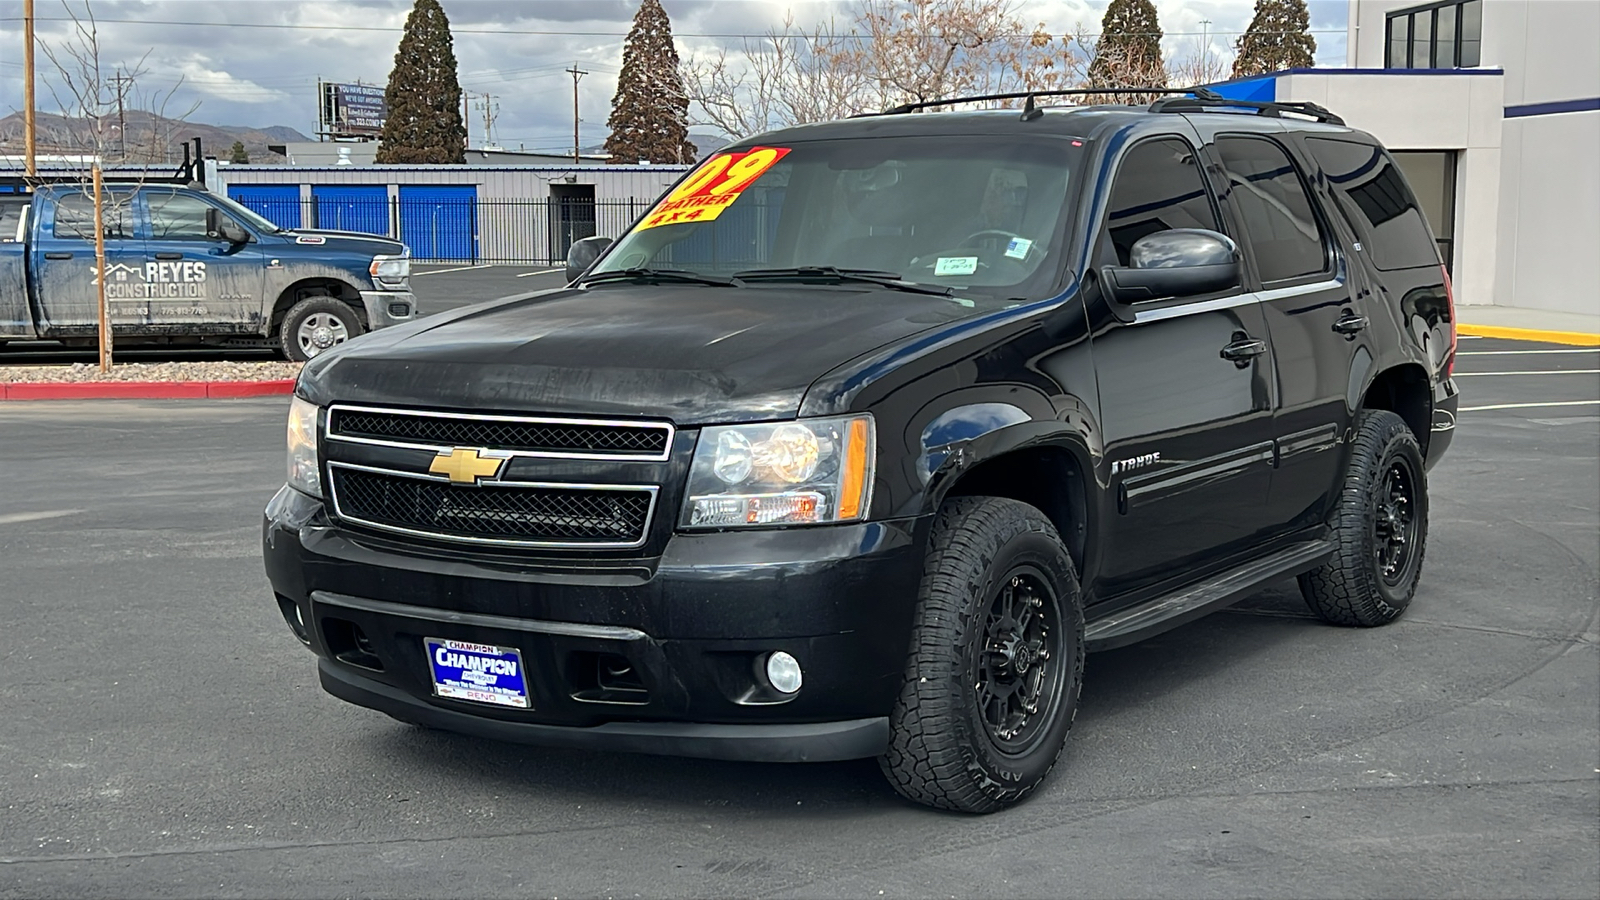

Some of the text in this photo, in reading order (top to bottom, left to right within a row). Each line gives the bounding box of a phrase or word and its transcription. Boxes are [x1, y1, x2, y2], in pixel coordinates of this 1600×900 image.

[350, 86, 362, 94] HAVE
[146, 262, 206, 282] REYES
[107, 283, 207, 298] CONSTRUCTION
[1120, 451, 1161, 472] TAHOE
[449, 641, 494, 654] CHAMPION
[435, 648, 517, 677] CHAMPION
[463, 672, 495, 683] CHEVROLET
[467, 691, 497, 702] RENO
